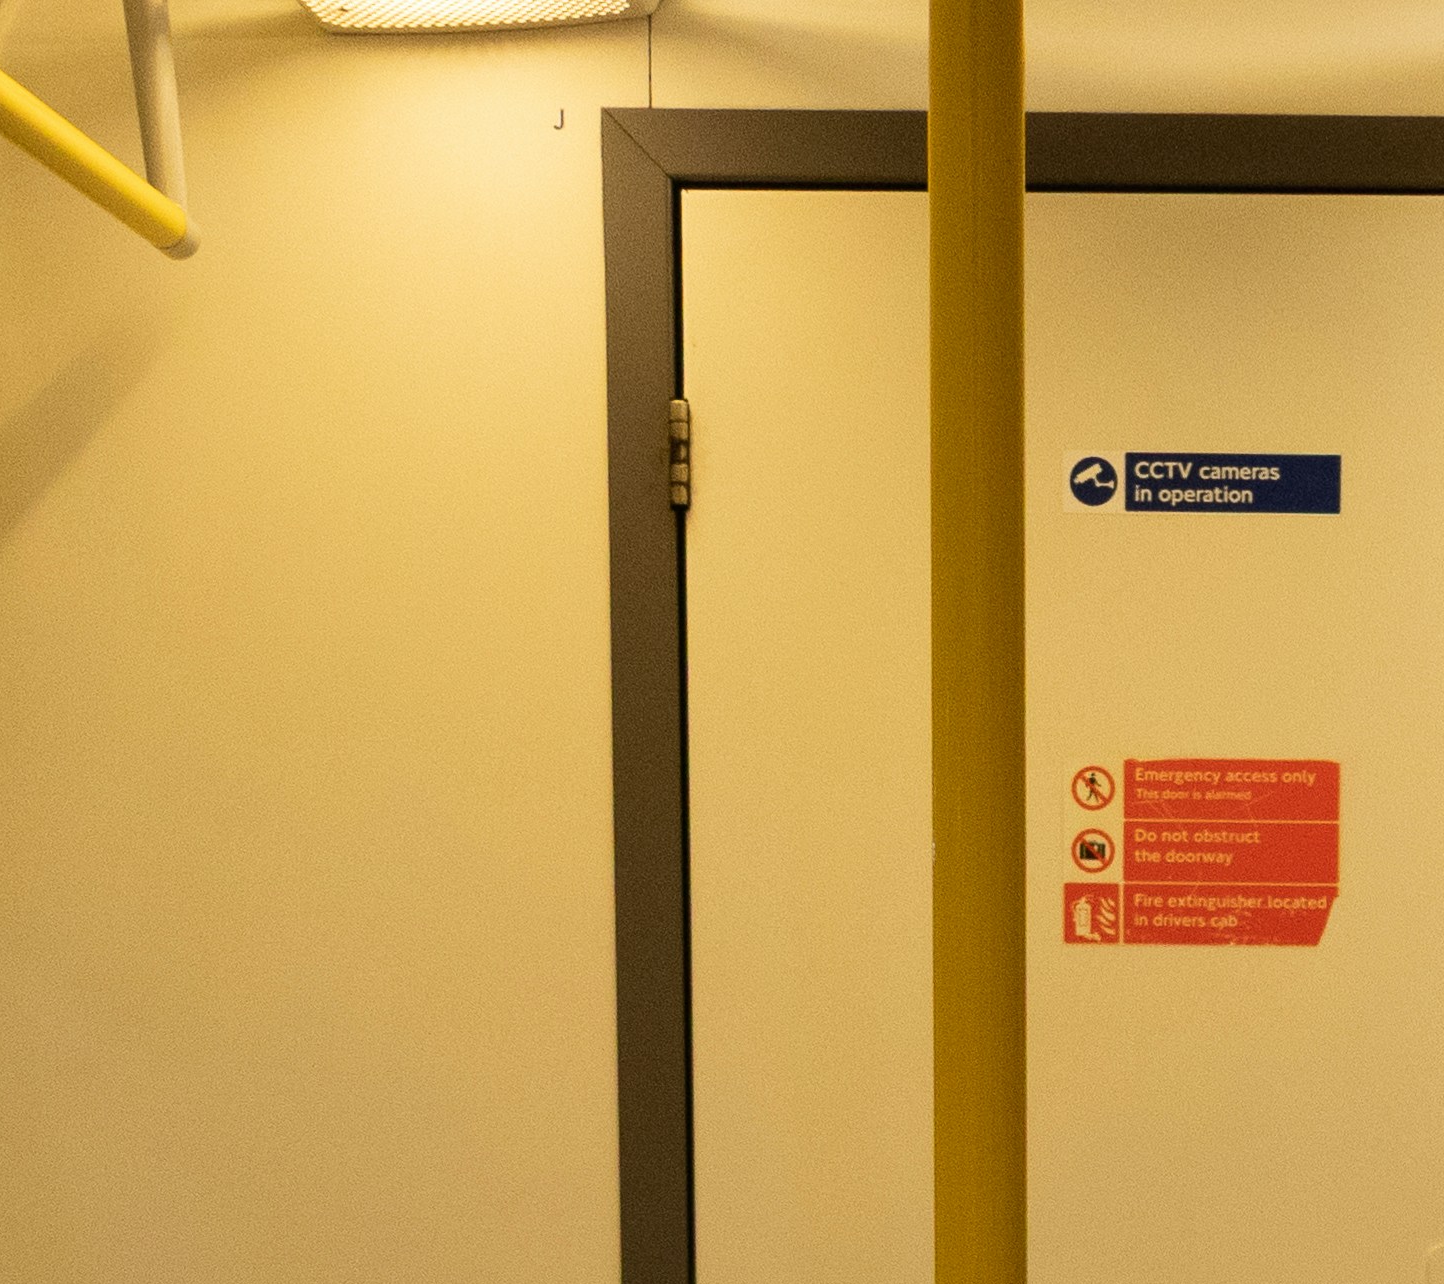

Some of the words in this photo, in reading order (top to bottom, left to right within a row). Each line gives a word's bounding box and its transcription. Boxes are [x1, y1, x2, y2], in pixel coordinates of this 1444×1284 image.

[554, 108, 564, 130] J
[1134, 461, 1193, 480] CCTV
[1199, 465, 1281, 480] cameras
[1134, 484, 1152, 502] in
[1158, 486, 1254, 506] operation
[1135, 767, 1221, 785] Emergency
[1225, 771, 1278, 783] access
[1281, 770, 1317, 787] only
[1136, 787, 1159, 800] This
[1162, 788, 1189, 800] door
[1206, 789, 1253, 801] alarmed
[1134, 828, 1157, 843] Do
[1161, 830, 1189, 843] not
[1193, 829, 1261, 844] obstruct
[1134, 849, 1161, 863] the
[1165, 849, 1233, 867] doorway
[1134, 893, 1164, 908] Fire
[1168, 894, 1263, 912] extinguisher
[1267, 895, 1328, 909] located
[1133, 914, 1148, 927] in
[1152, 914, 1206, 928] drivers
[1210, 914, 1238, 928] cab
